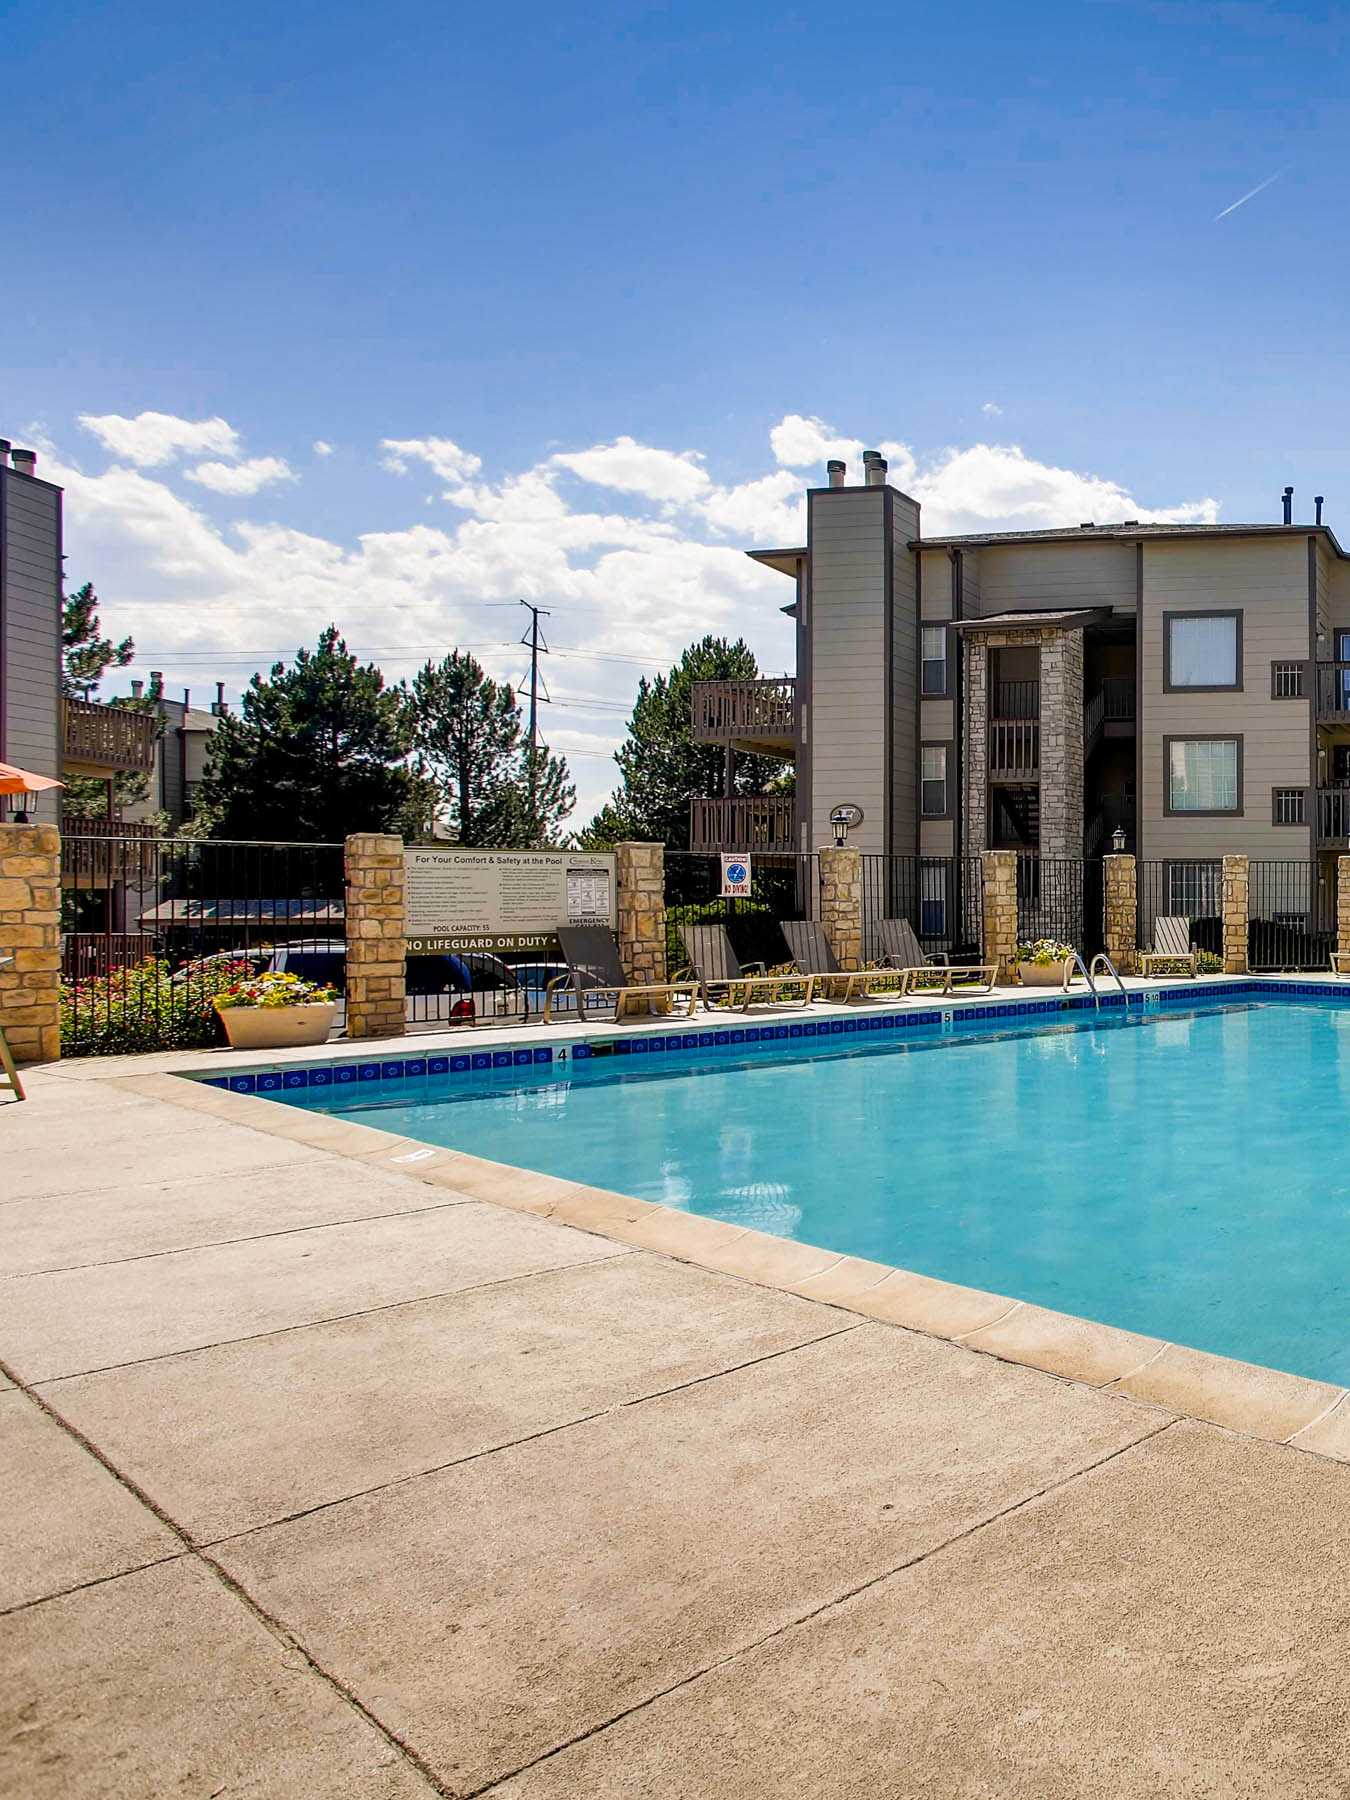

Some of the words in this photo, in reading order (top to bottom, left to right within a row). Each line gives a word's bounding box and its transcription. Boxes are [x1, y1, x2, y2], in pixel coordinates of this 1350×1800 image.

[415, 855, 430, 864] For
[432, 855, 452, 864] Your
[453, 856, 487, 864] Comfort
[488, 856, 495, 864] &
[496, 856, 521, 866] Safety
[522, 857, 531, 865] at
[532, 857, 544, 865] the
[545, 857, 562, 865] Pool
[725, 885, 731, 893] NO
[407, 940, 423, 950] NO
[427, 938, 493, 950] LIFEGUARD
[497, 938, 514, 947] ON
[518, 936, 548, 946] DUTY
[944, 1012, 951, 1022] 5
[557, 1048, 568, 1061] 4
